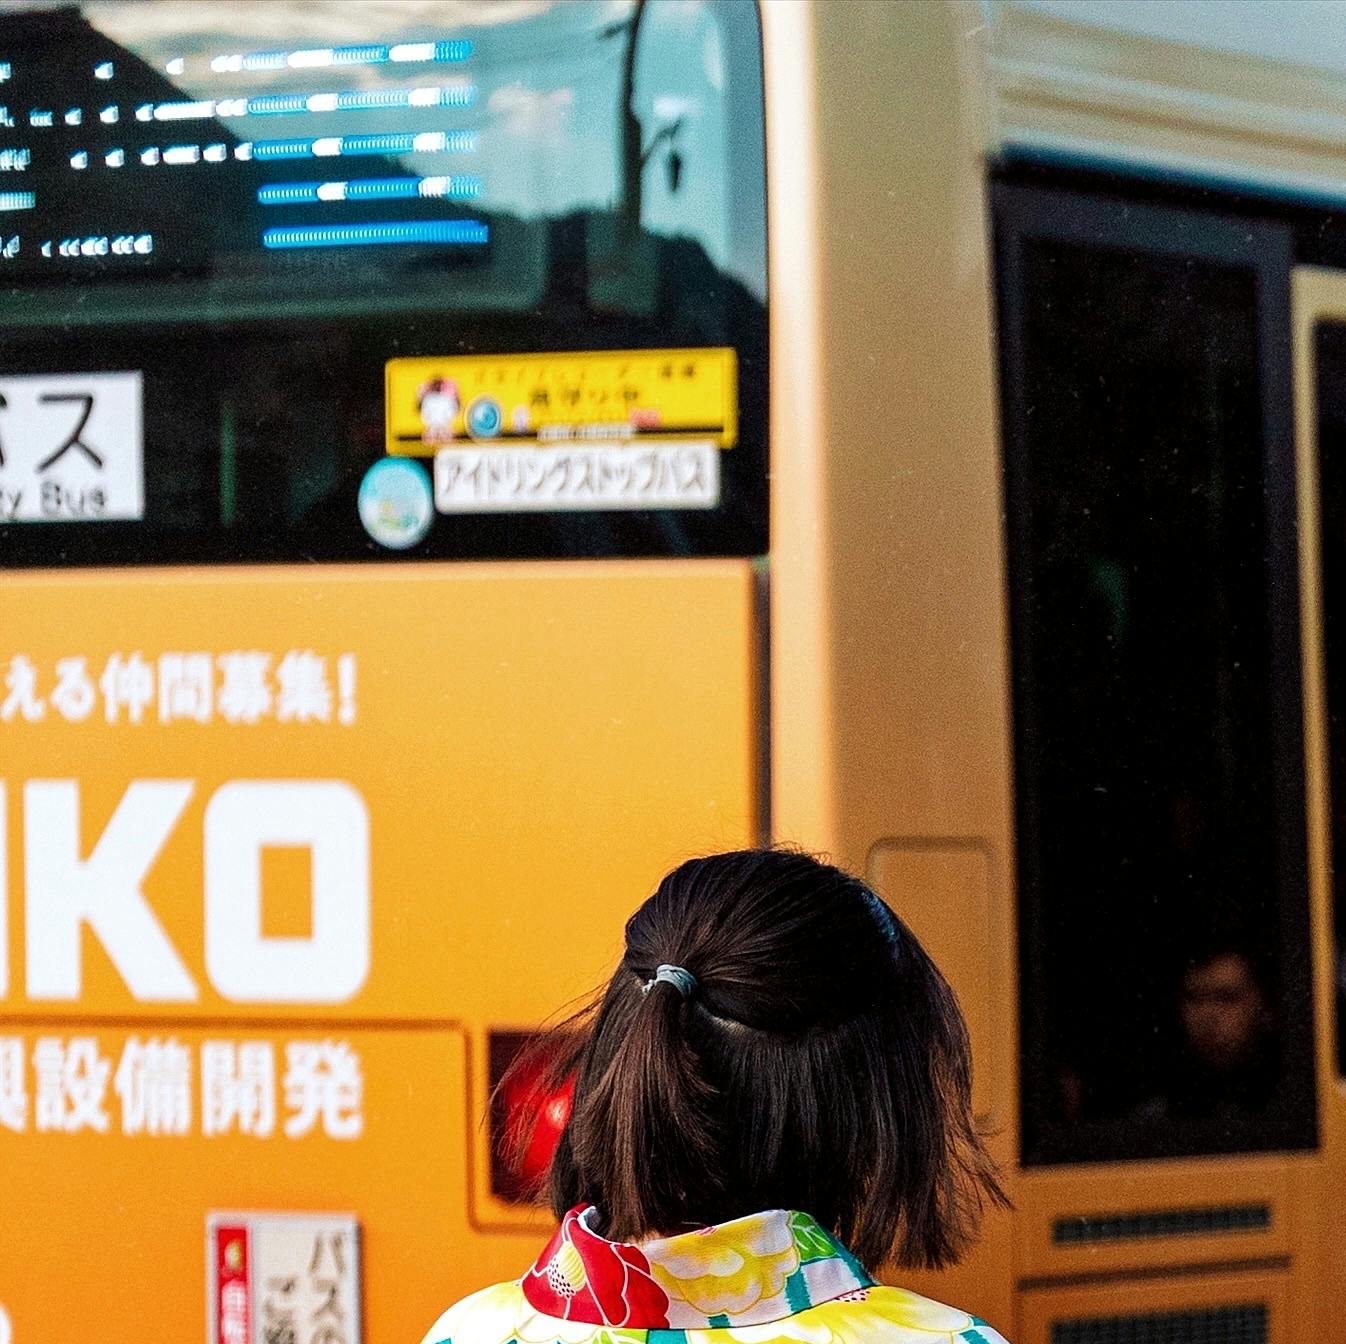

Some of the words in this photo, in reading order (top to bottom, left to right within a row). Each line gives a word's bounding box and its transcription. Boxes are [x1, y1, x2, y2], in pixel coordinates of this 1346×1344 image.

[0, 393, 103, 468] ス
[441, 448, 704, 500] アイドリングストップバス
[0, 778, 371, 1003] KO
